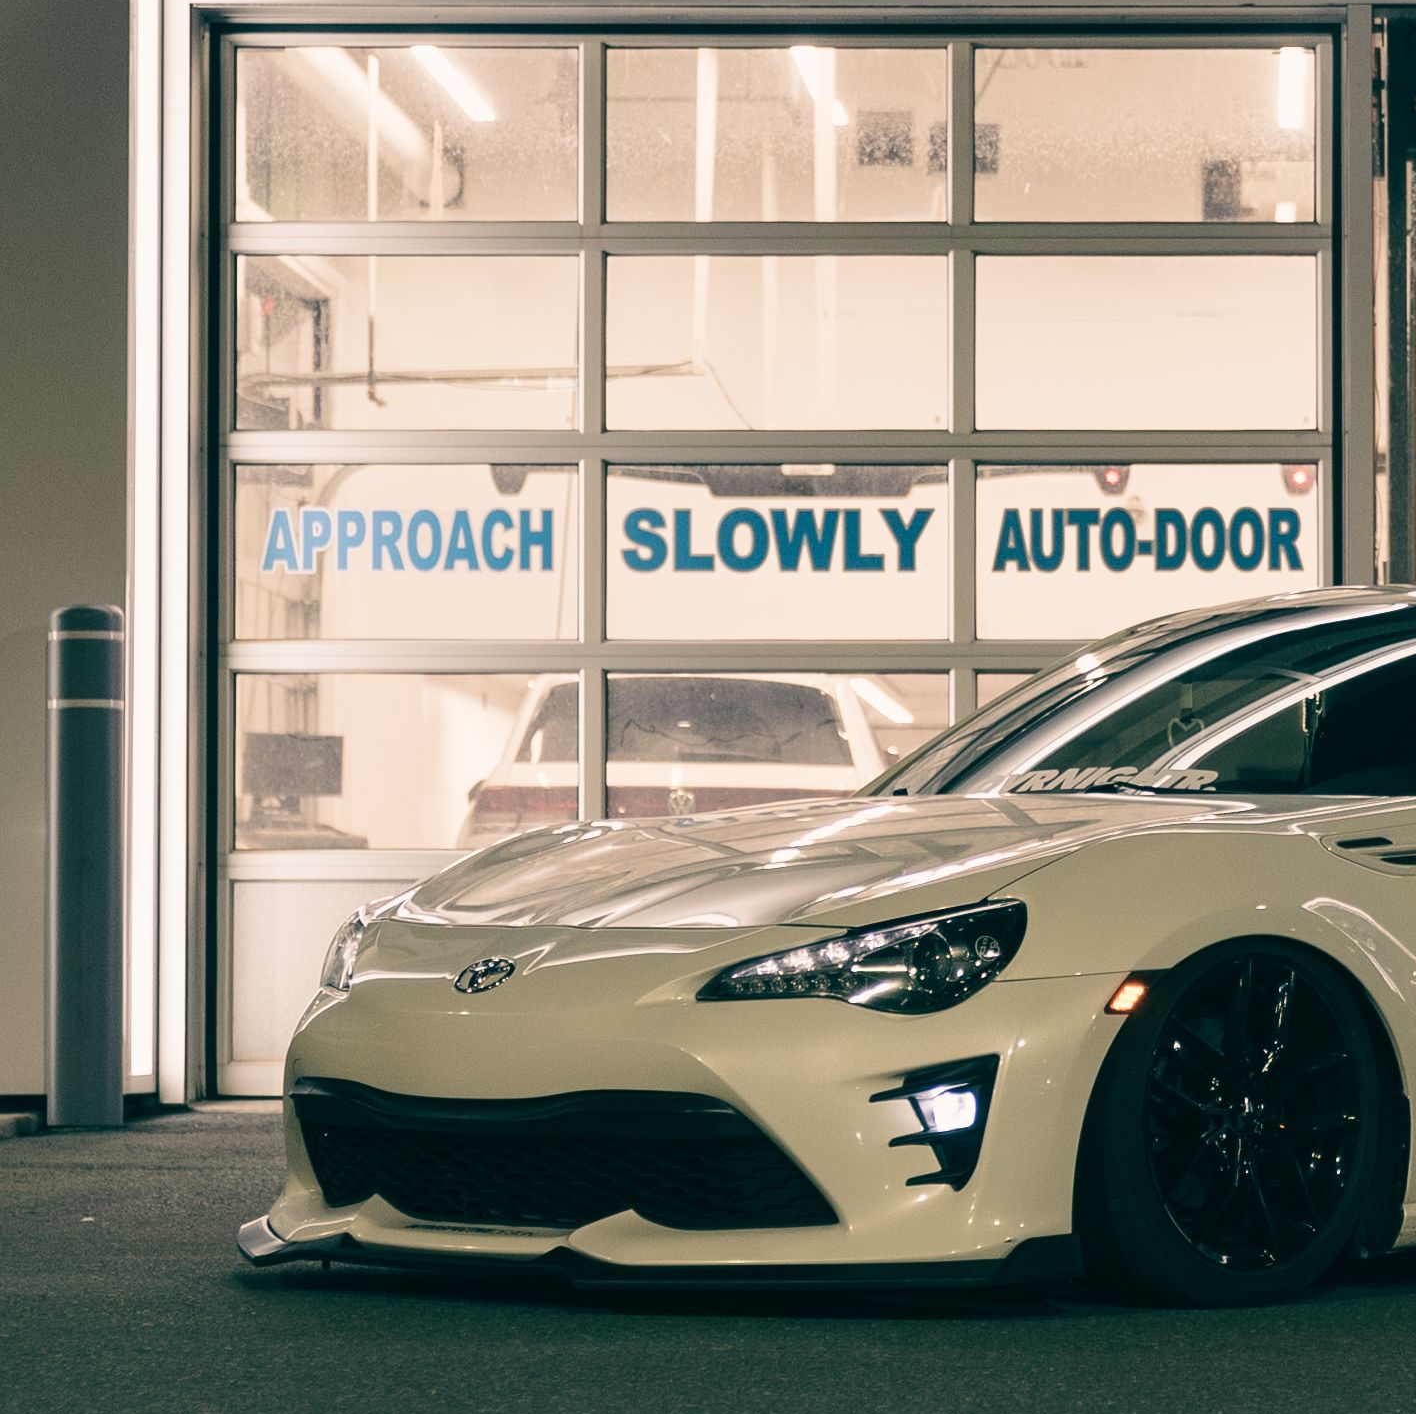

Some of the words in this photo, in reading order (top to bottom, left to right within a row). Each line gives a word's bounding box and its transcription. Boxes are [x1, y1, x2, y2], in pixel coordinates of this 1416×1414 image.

[262, 508, 554, 572] APPROACH
[622, 508, 934, 572] SLOWLY
[992, 507, 1304, 572] AUTO-DOOR
